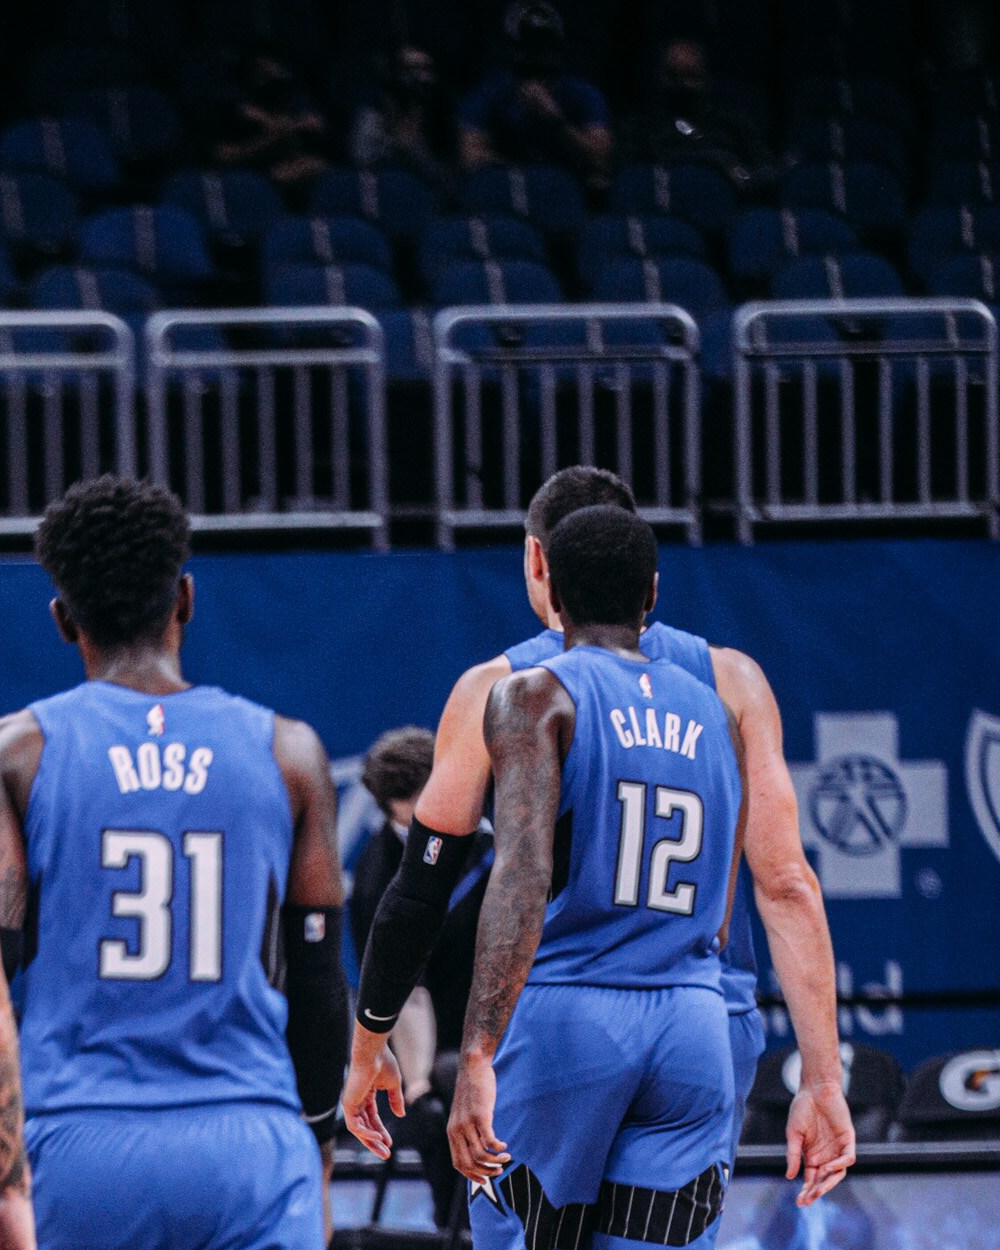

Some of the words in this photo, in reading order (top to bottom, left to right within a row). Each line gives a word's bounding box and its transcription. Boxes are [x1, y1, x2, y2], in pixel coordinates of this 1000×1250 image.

[109, 743, 212, 794] ROSS
[611, 707, 703, 759] CLARK
[614, 781, 703, 916] 12
[98, 829, 224, 983] 31
